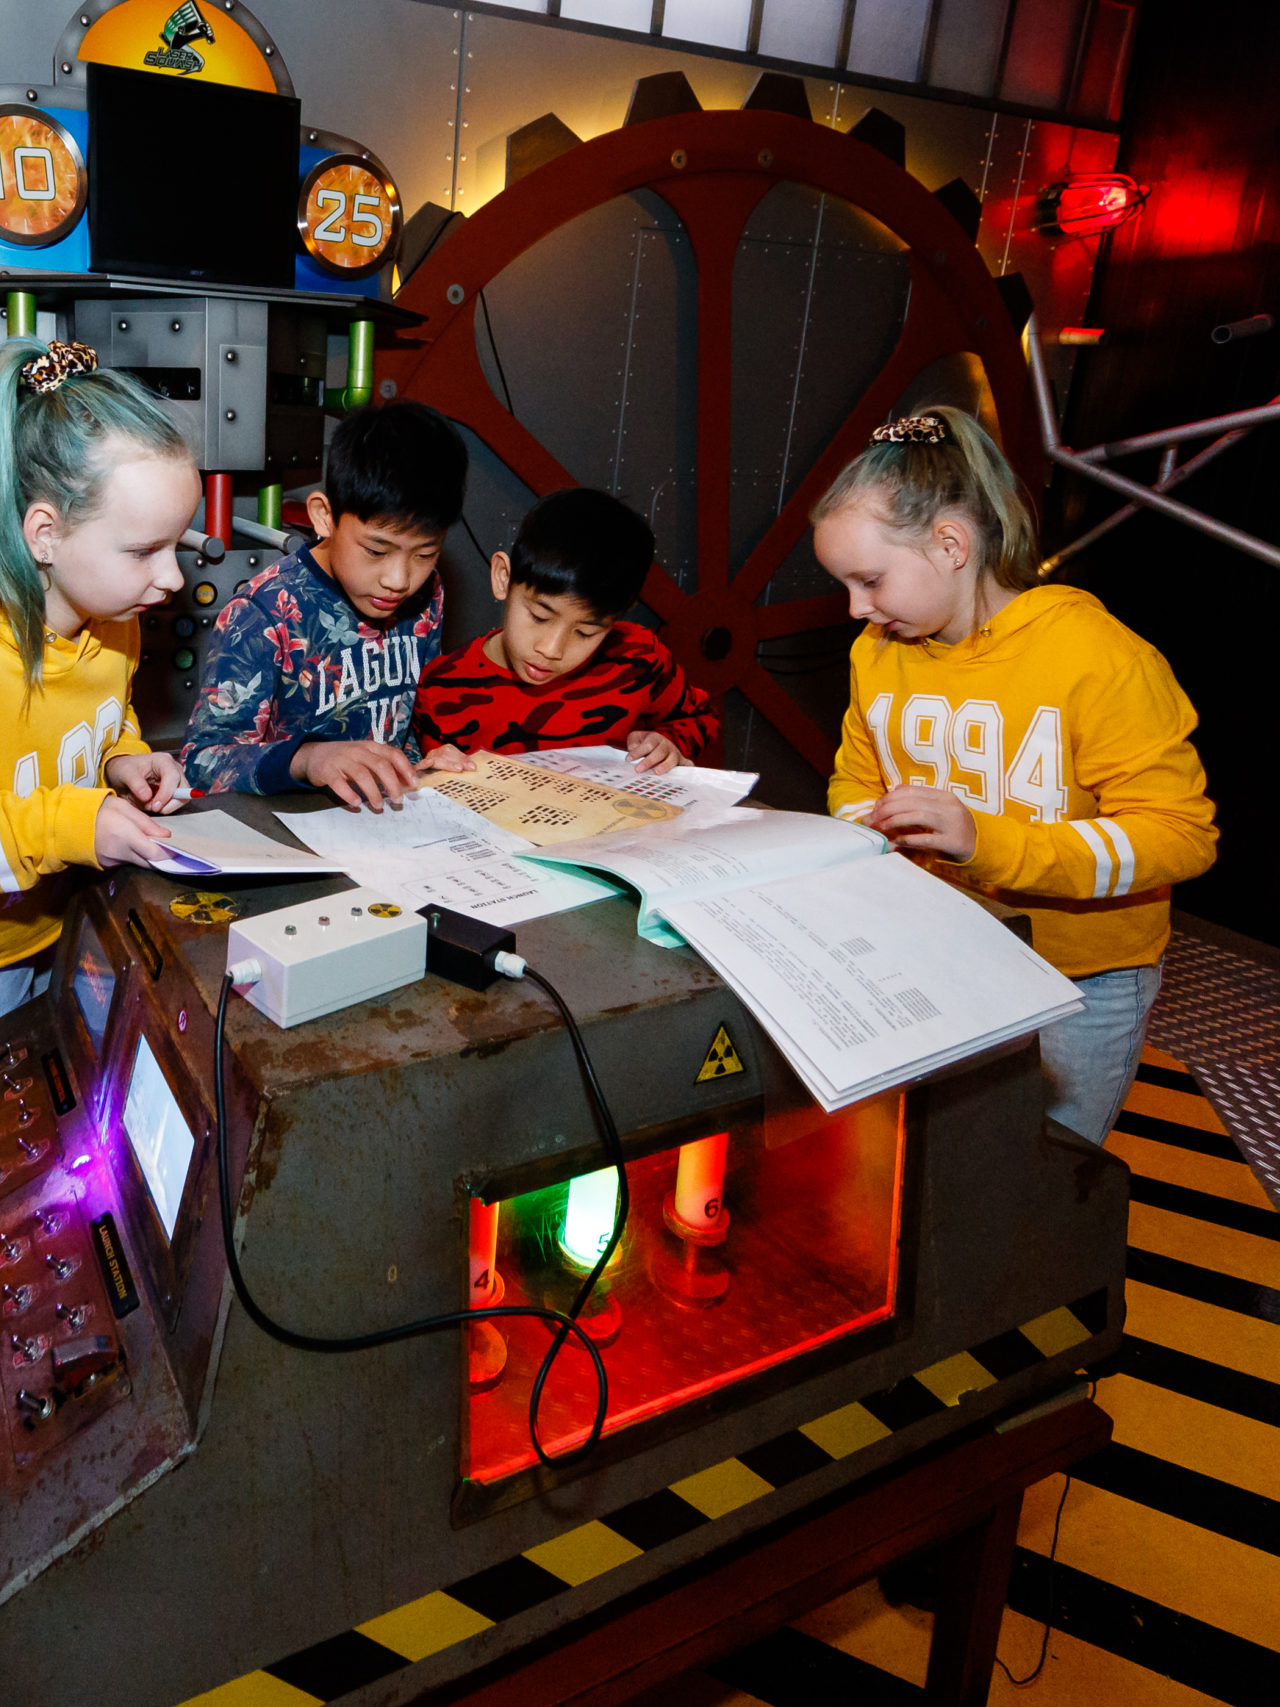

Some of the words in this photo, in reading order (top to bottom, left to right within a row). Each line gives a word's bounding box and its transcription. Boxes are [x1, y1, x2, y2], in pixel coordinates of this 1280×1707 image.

[144, 51, 203, 70] SQUASH
[158, 46, 194, 60] LASER
[313, 188, 383, 247] 25
[866, 692, 1068, 824] 1994
[704, 1198, 719, 1219] 6
[596, 1232, 611, 1254] 5
[99, 1224, 114, 1260] LAUNCH
[109, 1258, 128, 1299] STATION
[474, 1268, 490, 1290] 4
